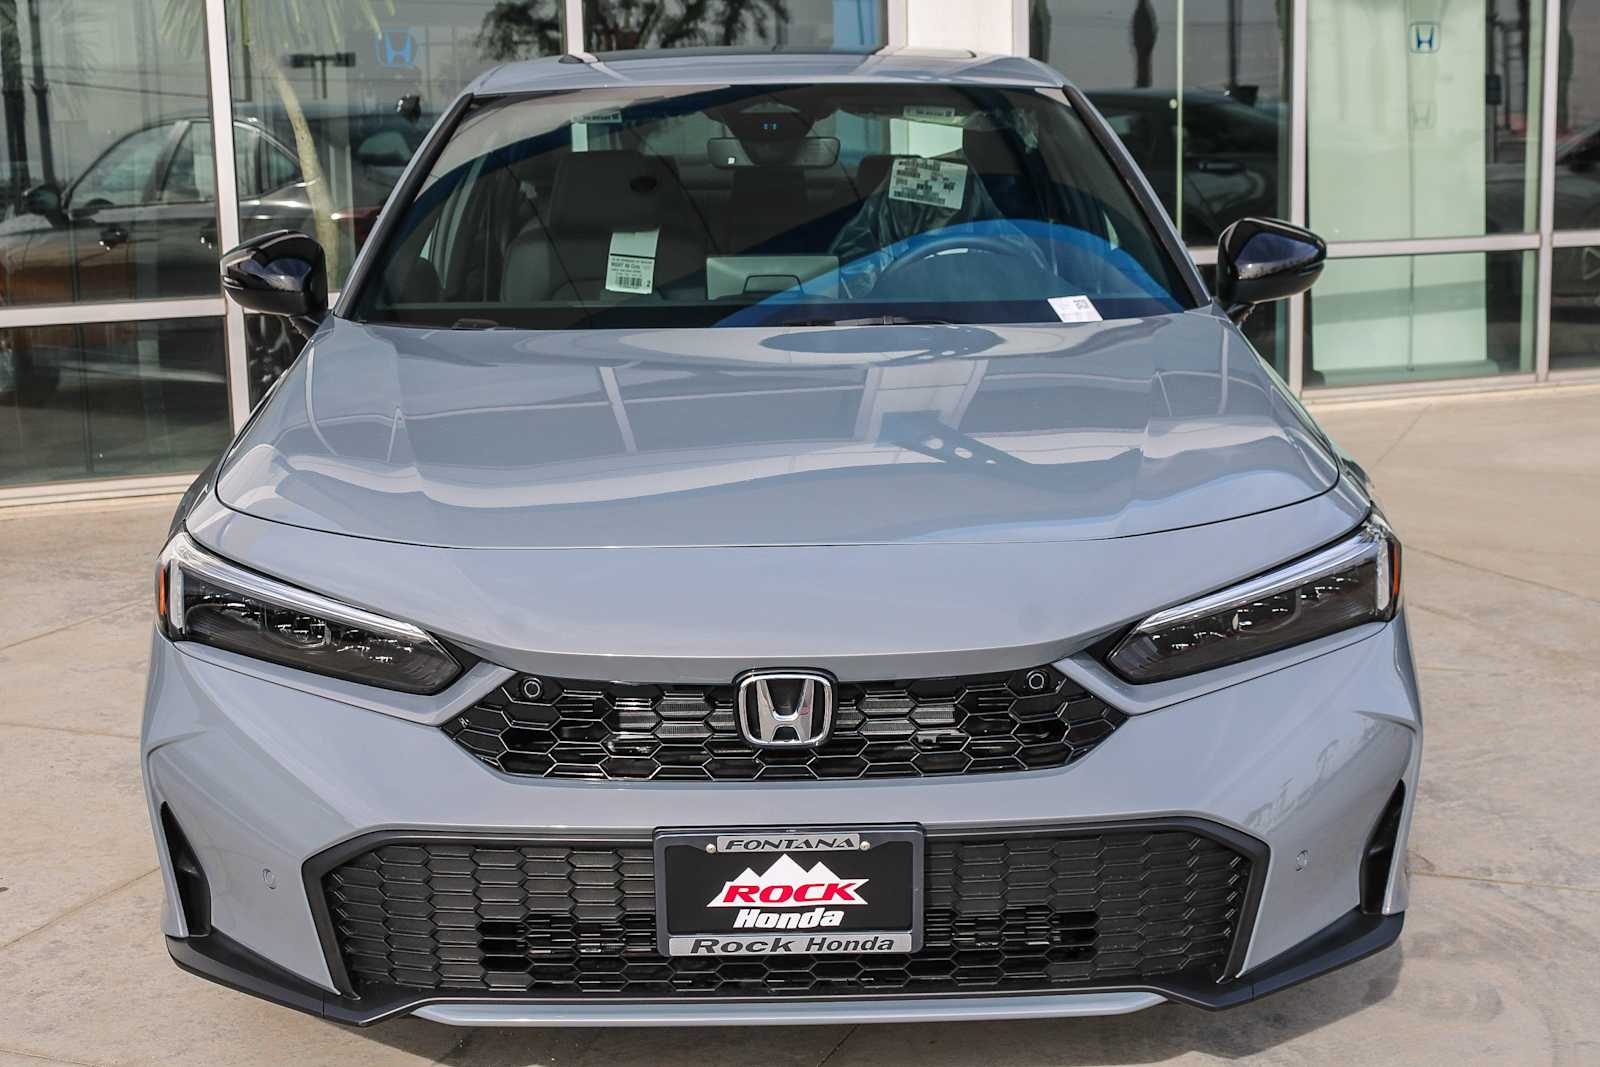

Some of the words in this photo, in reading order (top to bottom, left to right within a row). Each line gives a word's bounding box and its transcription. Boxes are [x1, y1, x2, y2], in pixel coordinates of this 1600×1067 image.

[725, 838, 853, 850] FONTANA
[723, 883, 856, 903] ROCK
[733, 908, 844, 928] Honda
[690, 937, 796, 953] Rock
[806, 937, 894, 952] Honda
